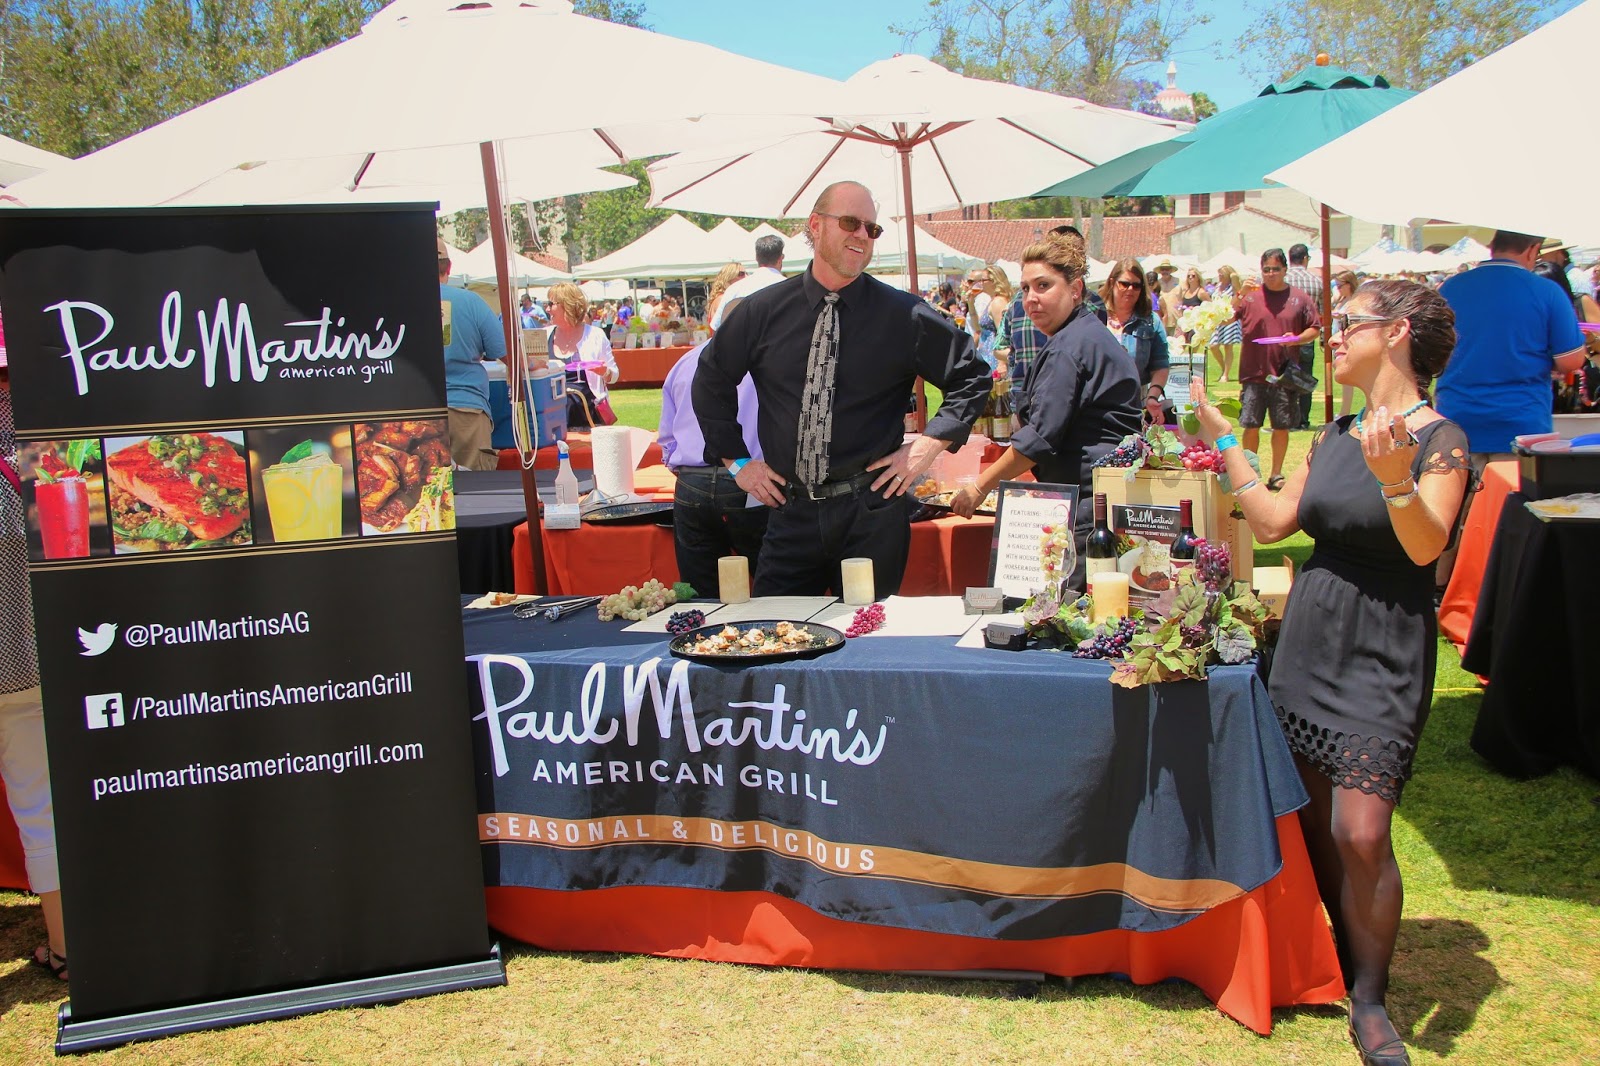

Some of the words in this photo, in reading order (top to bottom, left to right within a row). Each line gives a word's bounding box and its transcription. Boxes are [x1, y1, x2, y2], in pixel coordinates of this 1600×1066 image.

[44, 291, 196, 395] Paul
[197, 297, 406, 388] Martin's
[280, 365, 356, 379] american
[361, 360, 393, 383] grill
[1124, 508, 1144, 527] Paul
[125, 611, 310, 648] @PaulMartinsAG
[132, 671, 412, 721] /PaulMartinsAmericanGrill
[466, 654, 619, 777] Paul
[624, 657, 887, 766] Martin's
[93, 742, 424, 801] paulmartinsamericangrill.com
[533, 758, 724, 786] AMERICAN
[740, 764, 838, 805] GRILL
[485, 816, 650, 843] SEASONAL
[673, 820, 689, 839] &
[711, 822, 876, 871] DELICIOUS
